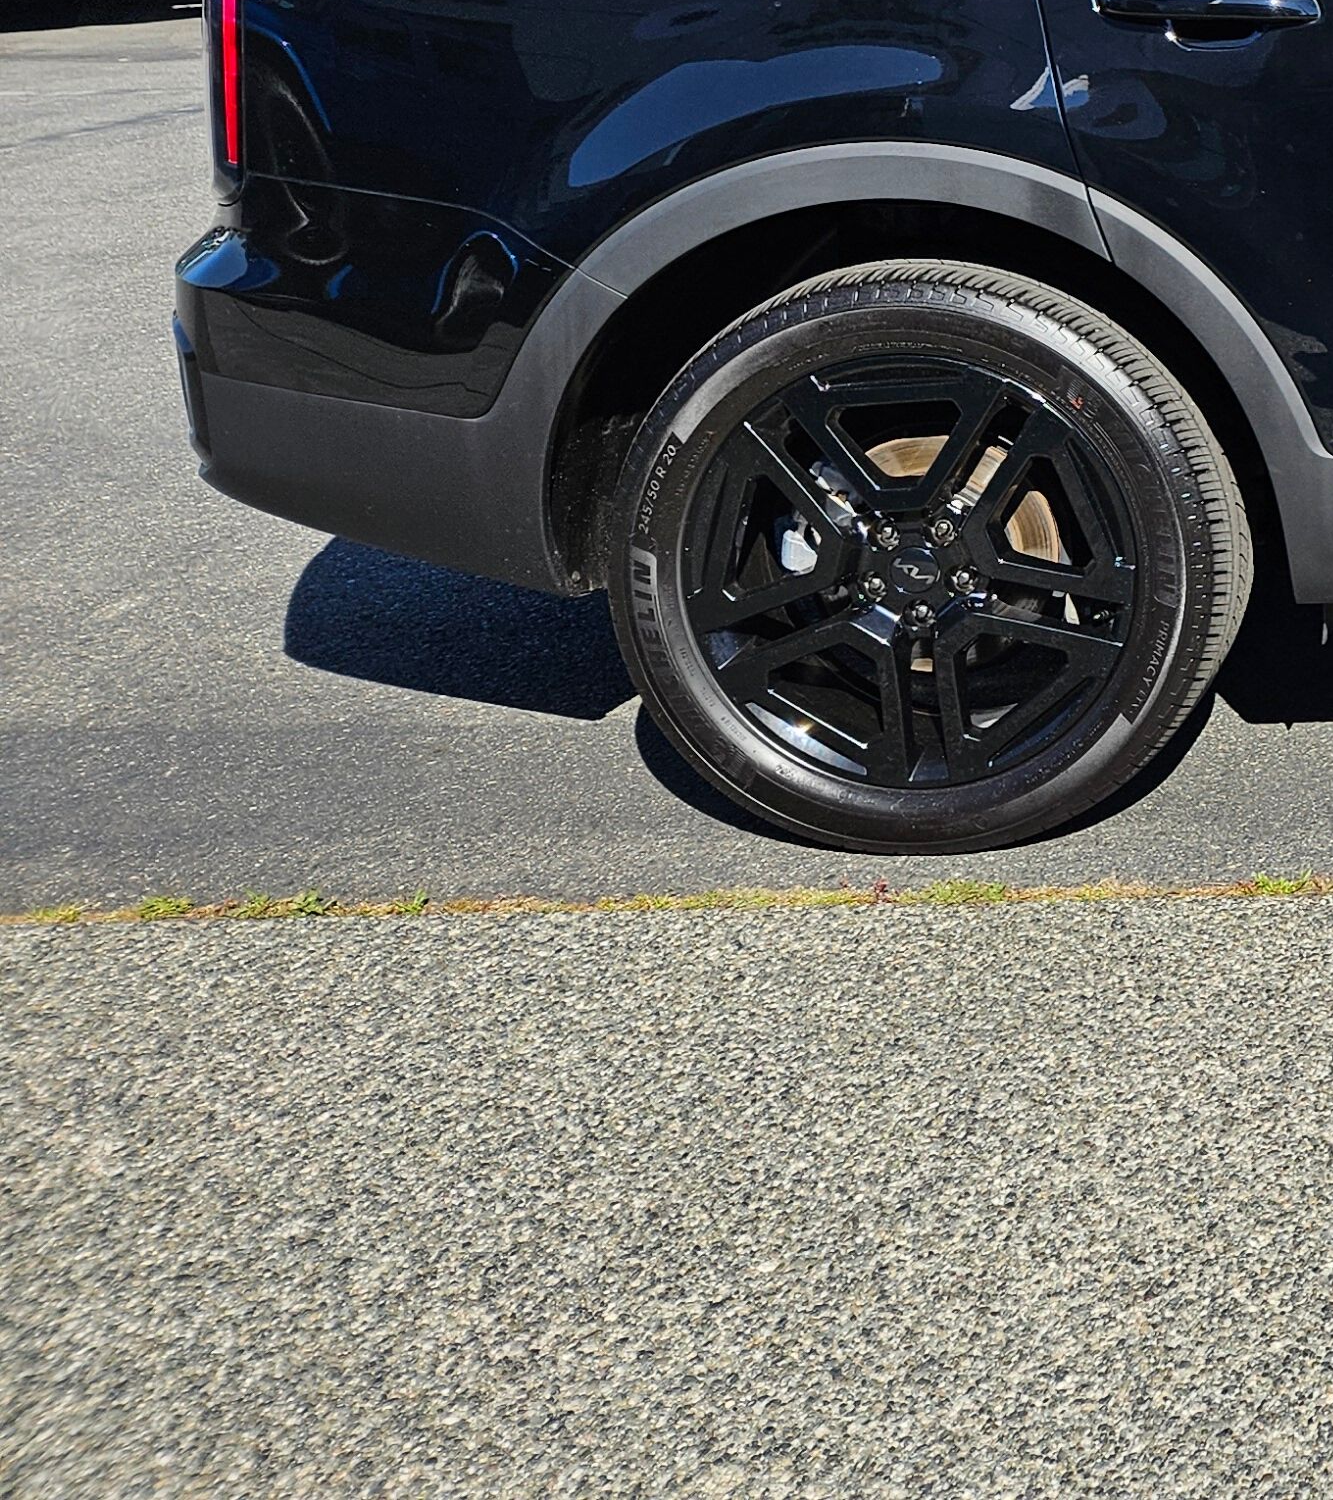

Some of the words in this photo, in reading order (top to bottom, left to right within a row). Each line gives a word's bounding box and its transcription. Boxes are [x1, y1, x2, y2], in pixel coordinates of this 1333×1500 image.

[638, 480, 661, 534] 245/50
[654, 466, 667, 479] R
[662, 444, 677, 465] 20
[1145, 620, 1171, 687] PRIMACY
